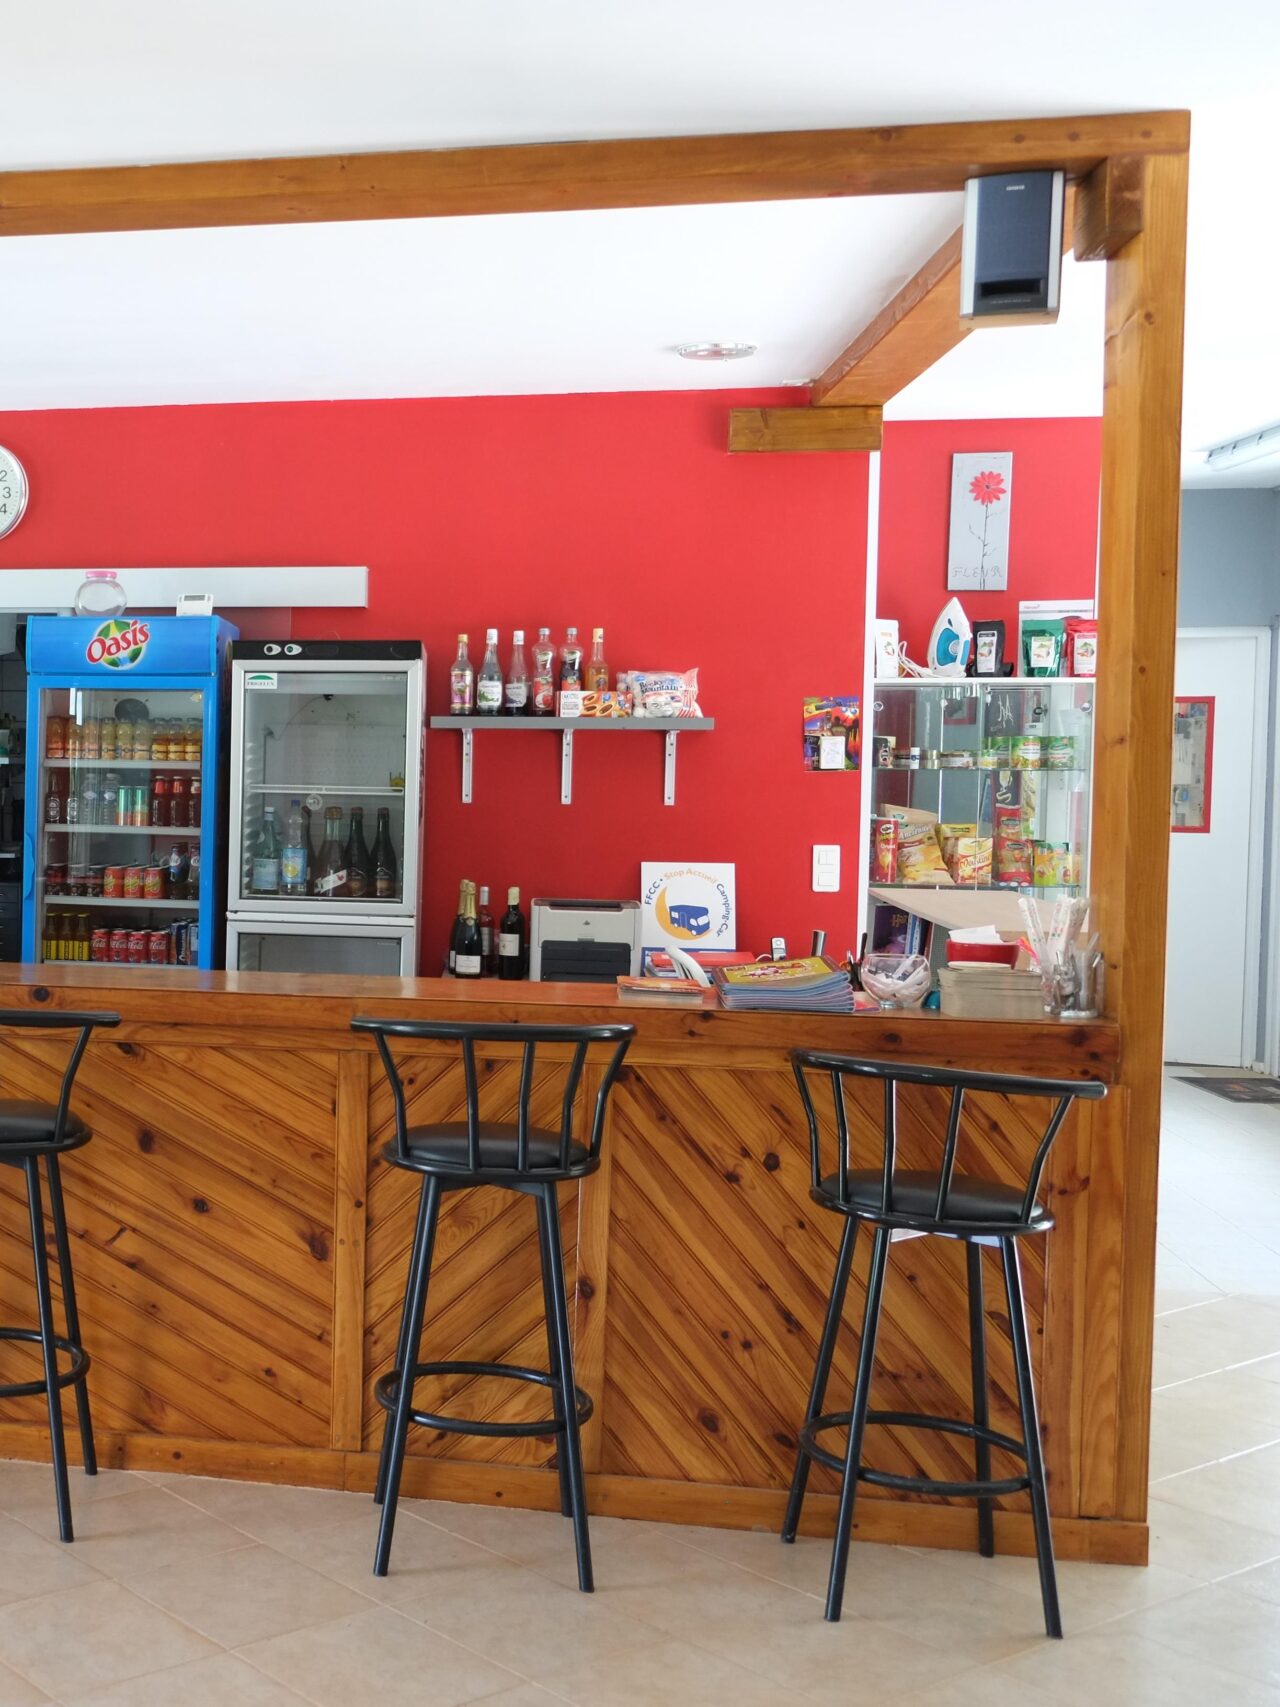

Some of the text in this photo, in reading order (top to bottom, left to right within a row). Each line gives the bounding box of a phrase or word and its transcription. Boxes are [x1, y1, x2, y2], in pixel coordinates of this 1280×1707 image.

[0, 470, 7, 481] 2
[3, 486, 12, 498] 3
[86, 619, 150, 664] Oasis
[644, 881, 661, 905] FFCC
[664, 869, 685, 880] Stop
